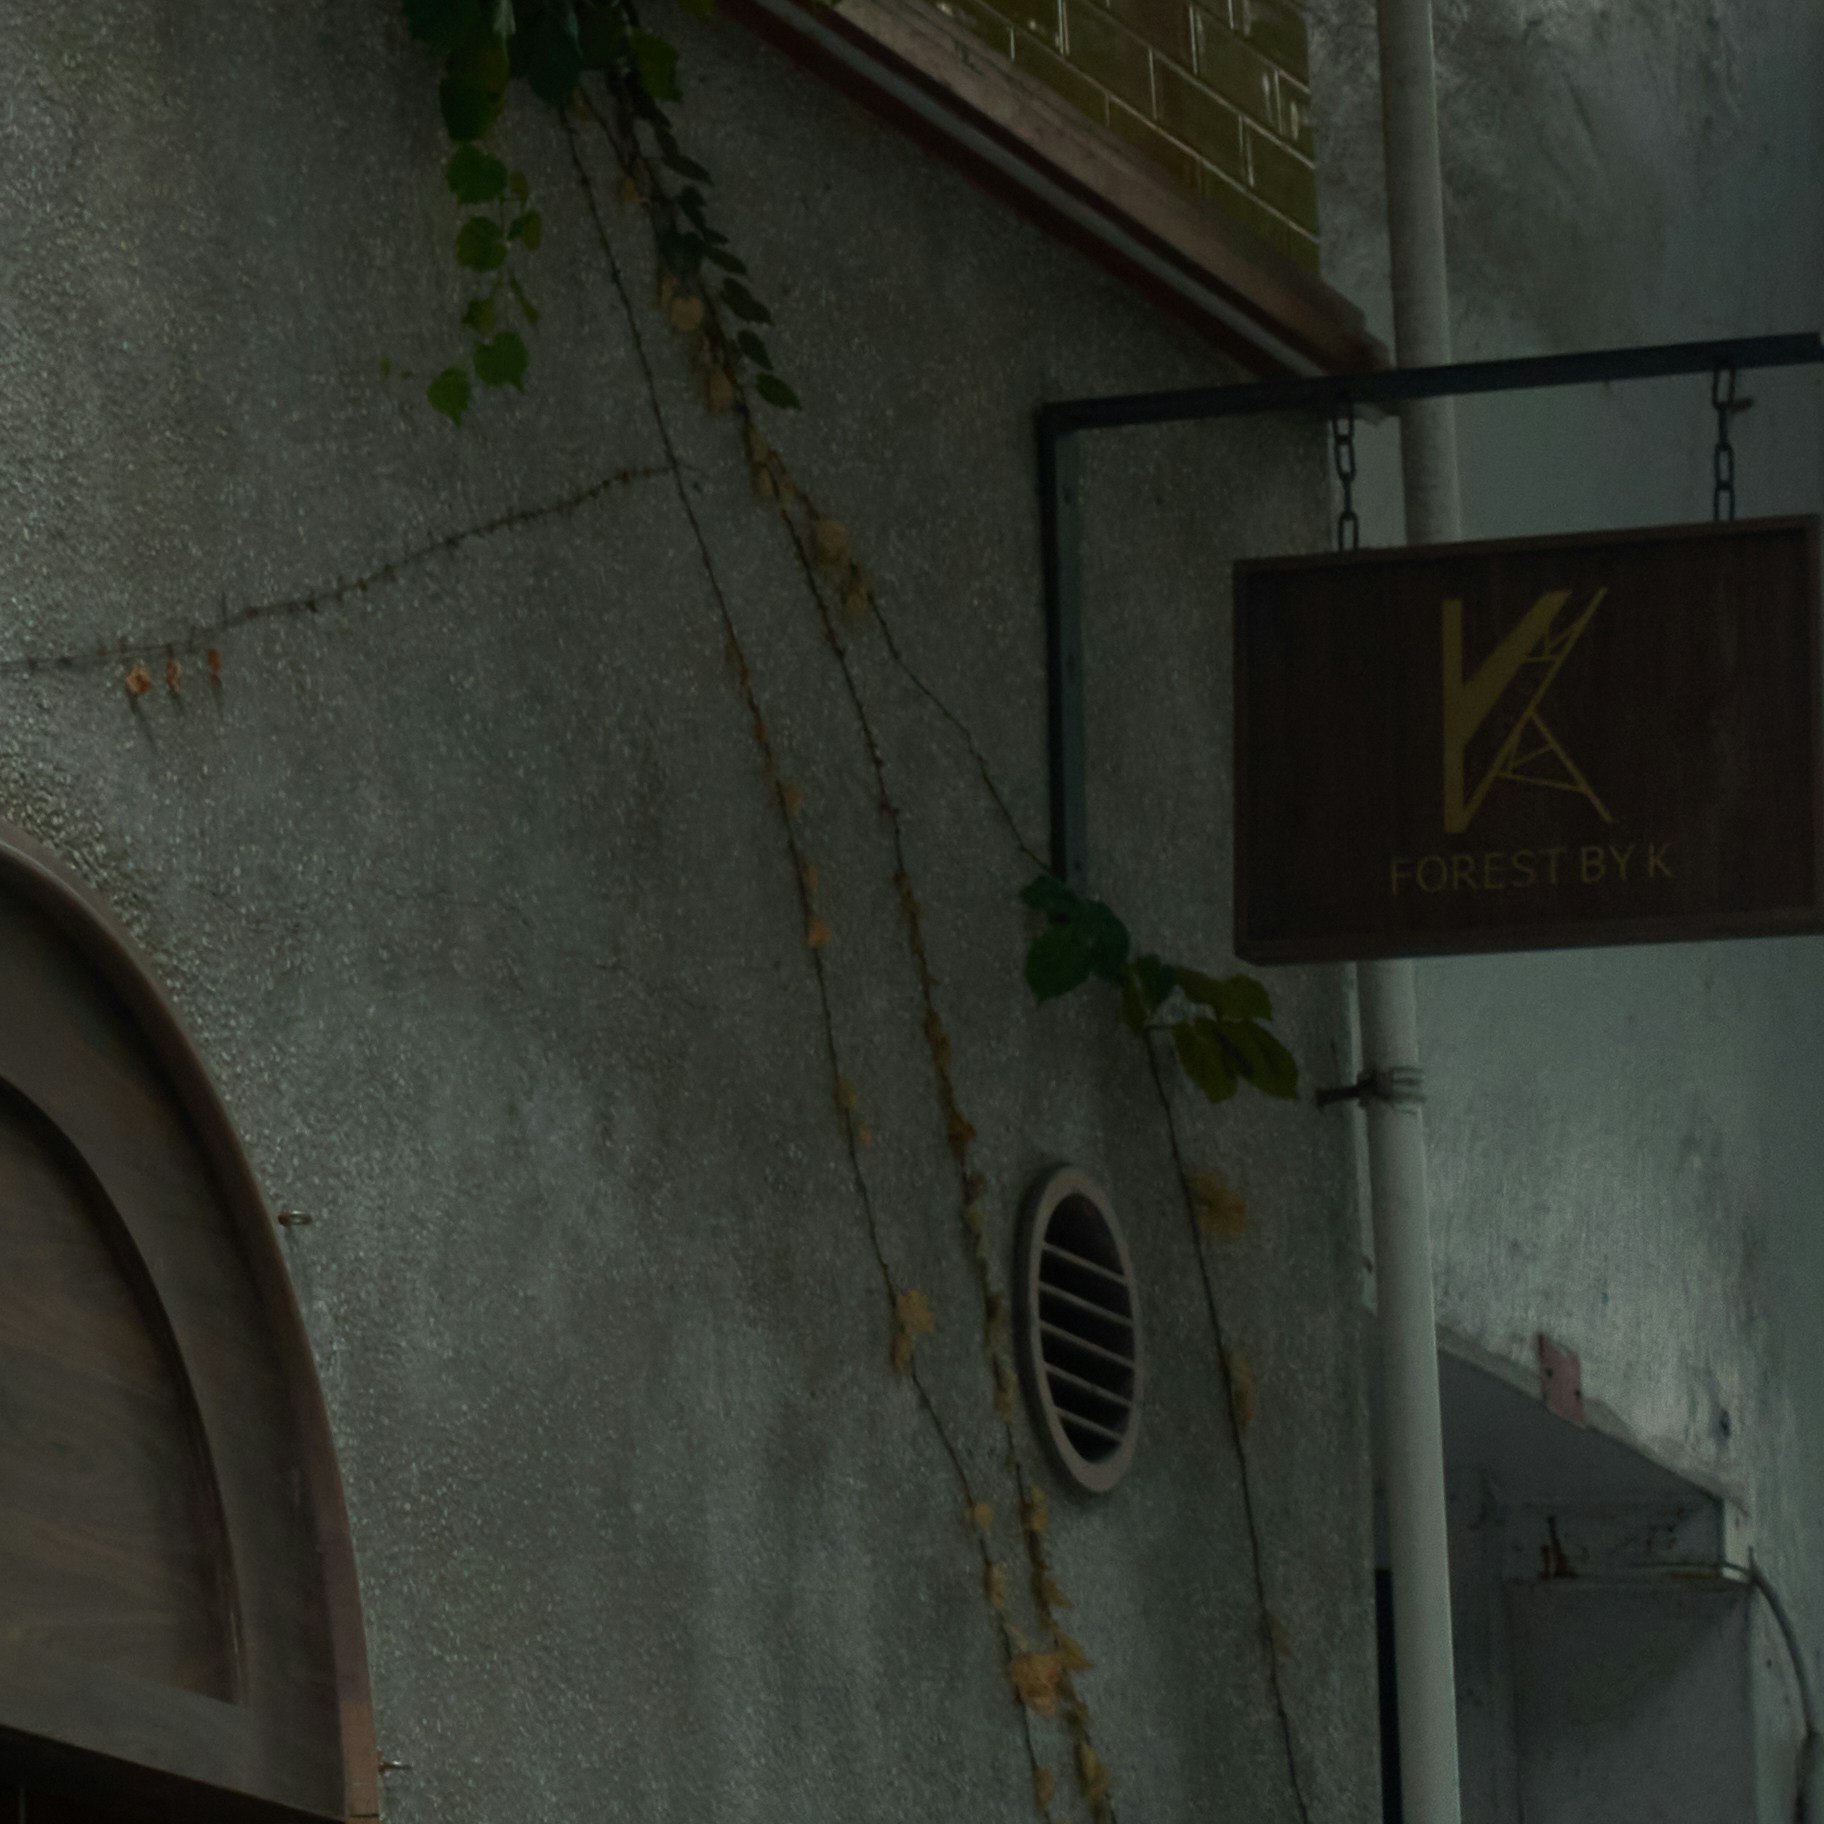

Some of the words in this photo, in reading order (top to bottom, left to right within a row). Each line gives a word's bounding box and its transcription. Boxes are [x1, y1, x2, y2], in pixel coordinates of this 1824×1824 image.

[1390, 847, 1568, 895] FOREST
[1580, 843, 1636, 883] BY
[1648, 841, 1675, 878] K
